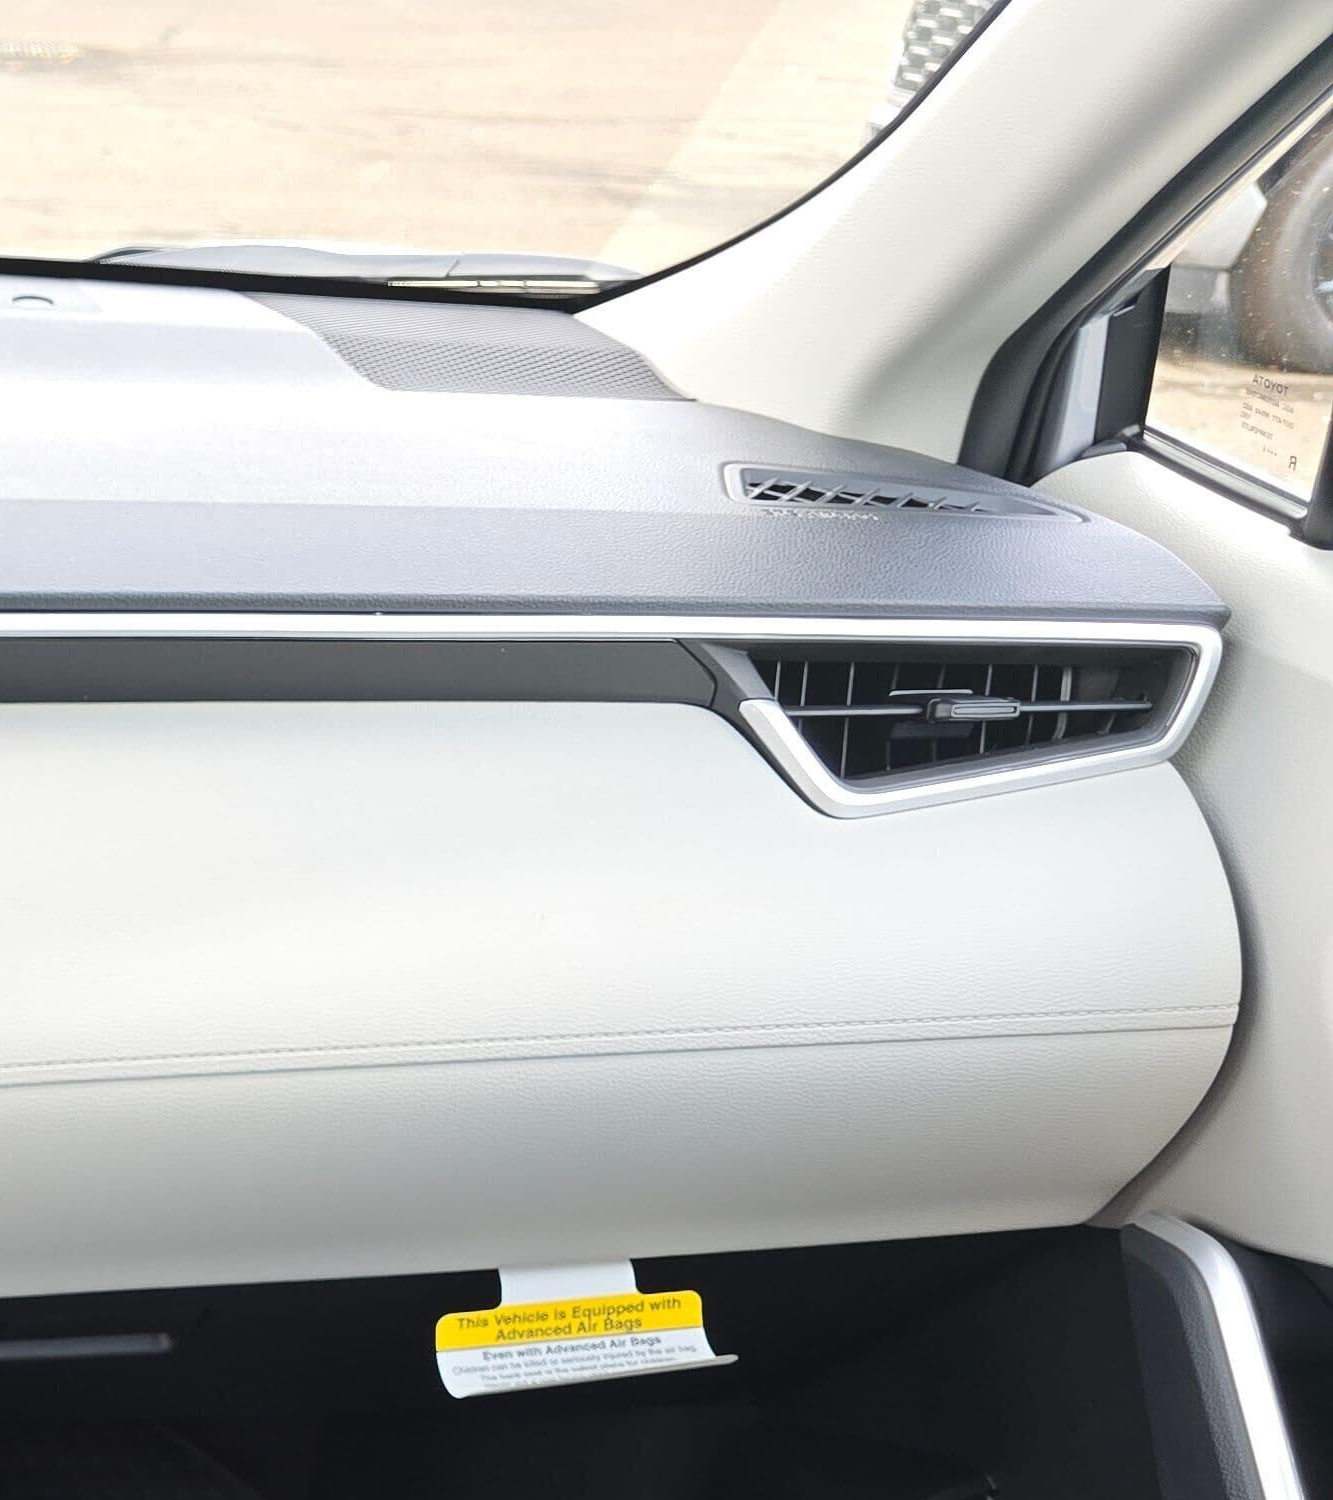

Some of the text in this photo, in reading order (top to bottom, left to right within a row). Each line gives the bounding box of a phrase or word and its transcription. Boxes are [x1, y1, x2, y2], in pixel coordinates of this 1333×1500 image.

[457, 1297, 681, 1330] This Vehicle is Equipped with
[495, 1317, 643, 1342] Advanced Air Bags
[482, 1336, 662, 1361] Even with Advanced Air Bags
